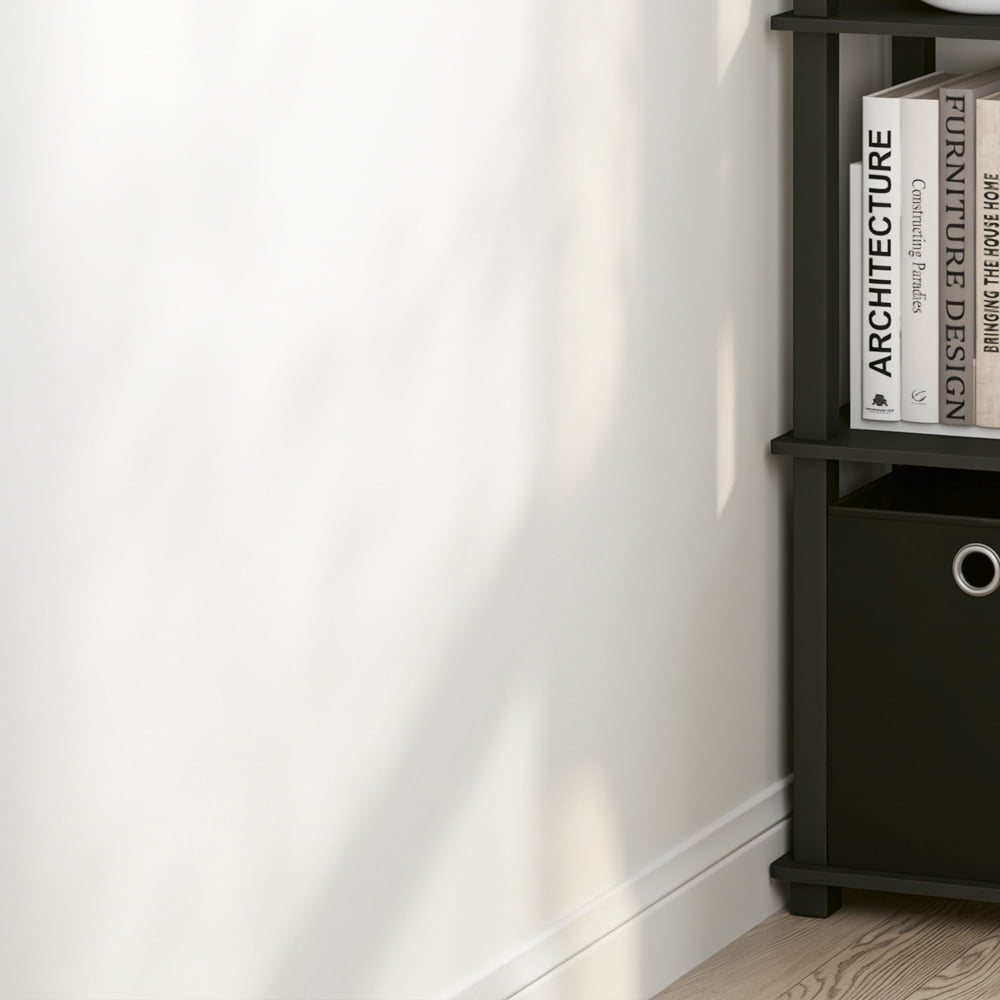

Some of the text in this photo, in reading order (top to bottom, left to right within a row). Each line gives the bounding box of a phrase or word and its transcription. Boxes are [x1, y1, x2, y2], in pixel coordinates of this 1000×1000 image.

[868, 130, 892, 378] ARCHITECTURE
[908, 178, 926, 258] Constructing
[945, 96, 965, 420] FURNITURE DESIGN
[984, 173, 1000, 353] BRINGING THE HOUSE HOME
